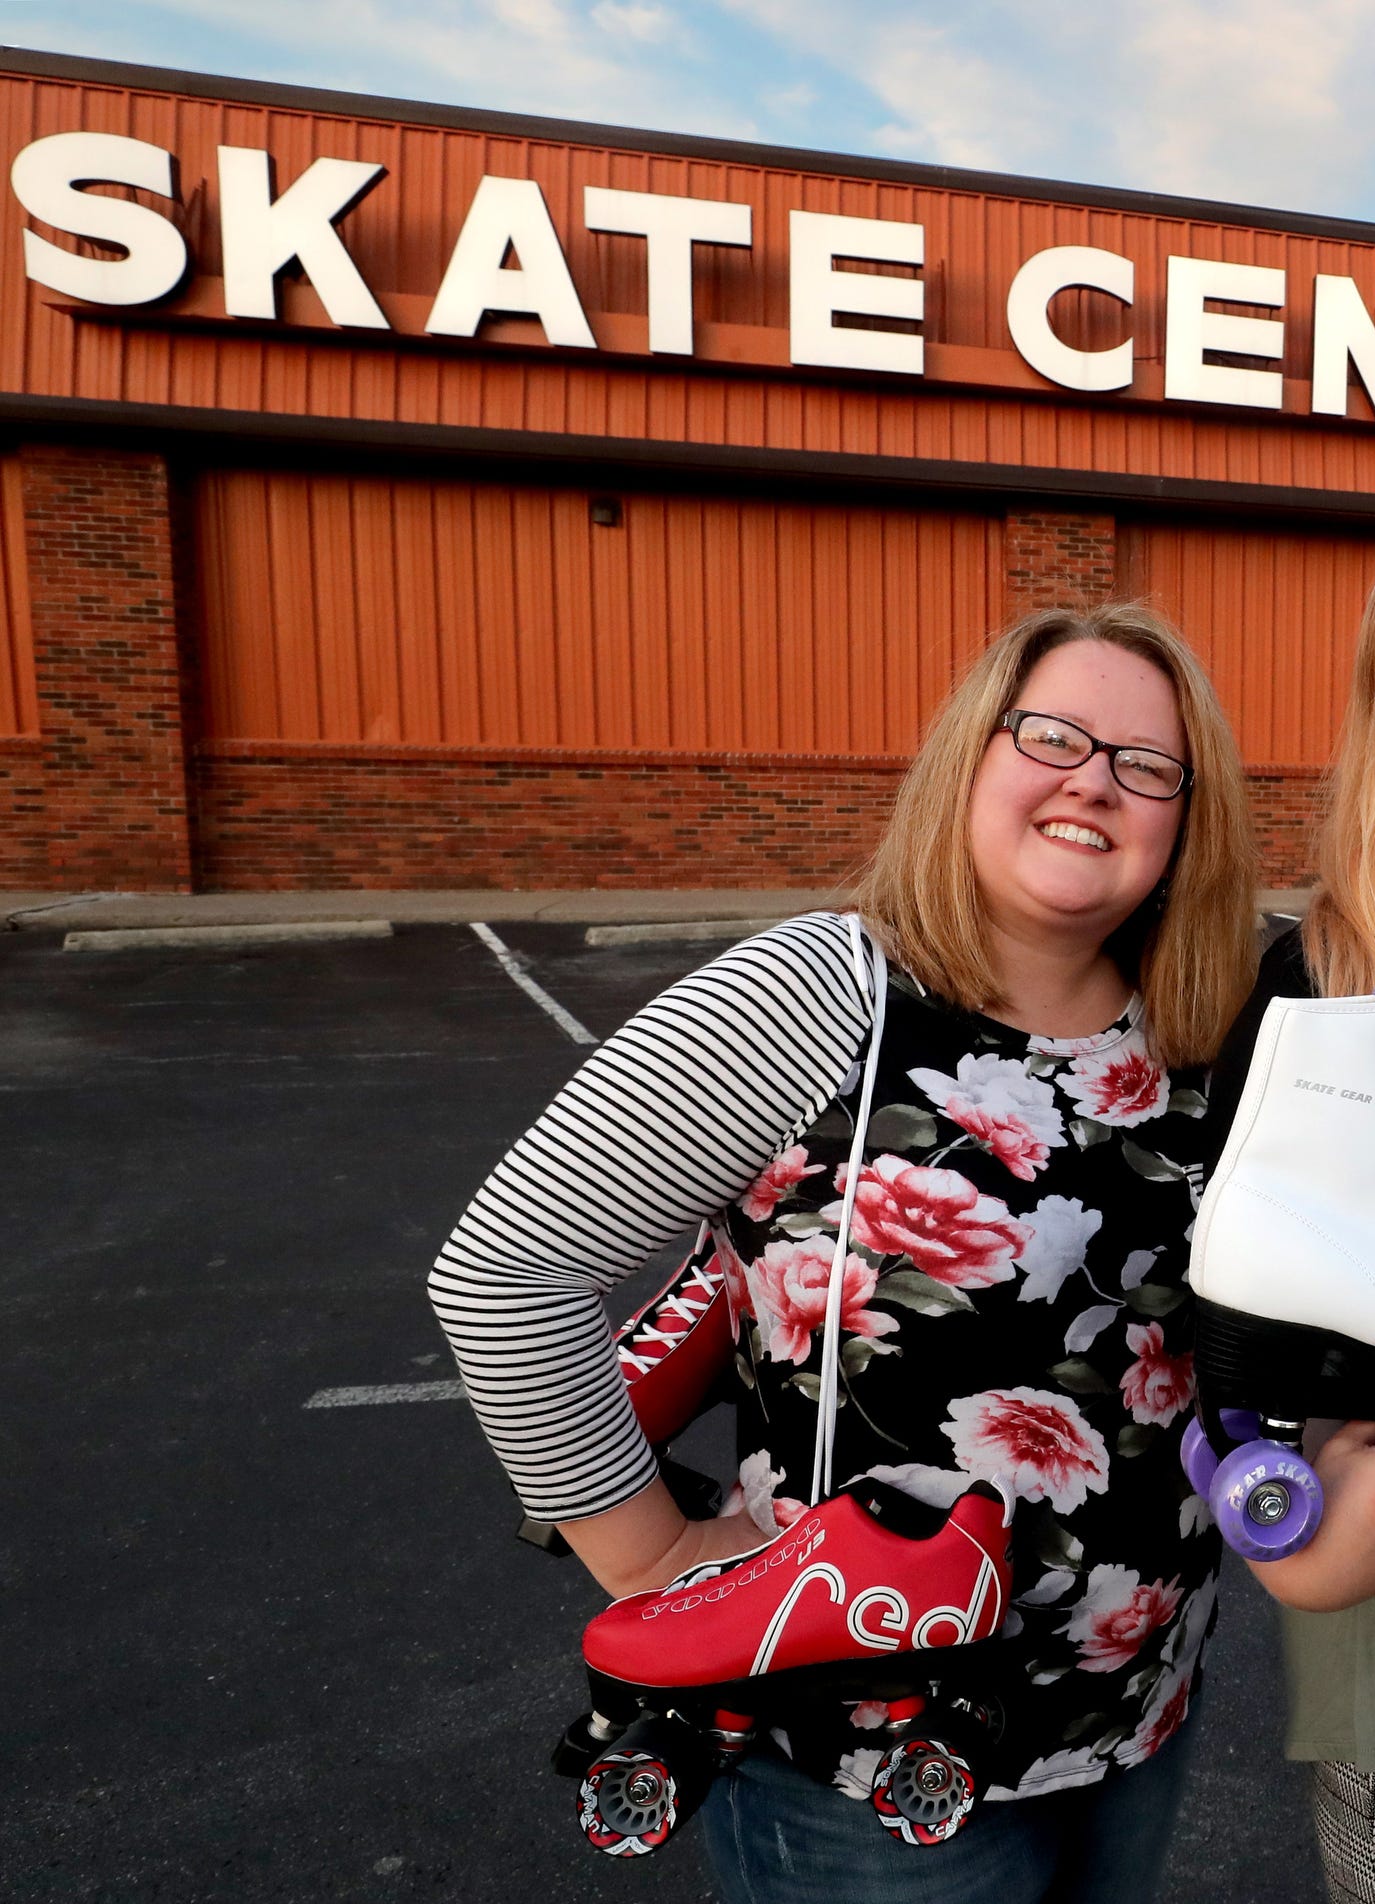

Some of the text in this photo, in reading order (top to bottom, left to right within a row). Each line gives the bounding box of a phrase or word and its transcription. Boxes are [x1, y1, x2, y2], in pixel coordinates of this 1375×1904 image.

[11, 132, 925, 376] SKATE
[1293, 1078, 1373, 1104] SKATE GEAR
[1275, 1461, 1320, 1500] SKATE
[749, 1553, 994, 1677] red
[583, 1775, 600, 1833] CAYMAN
